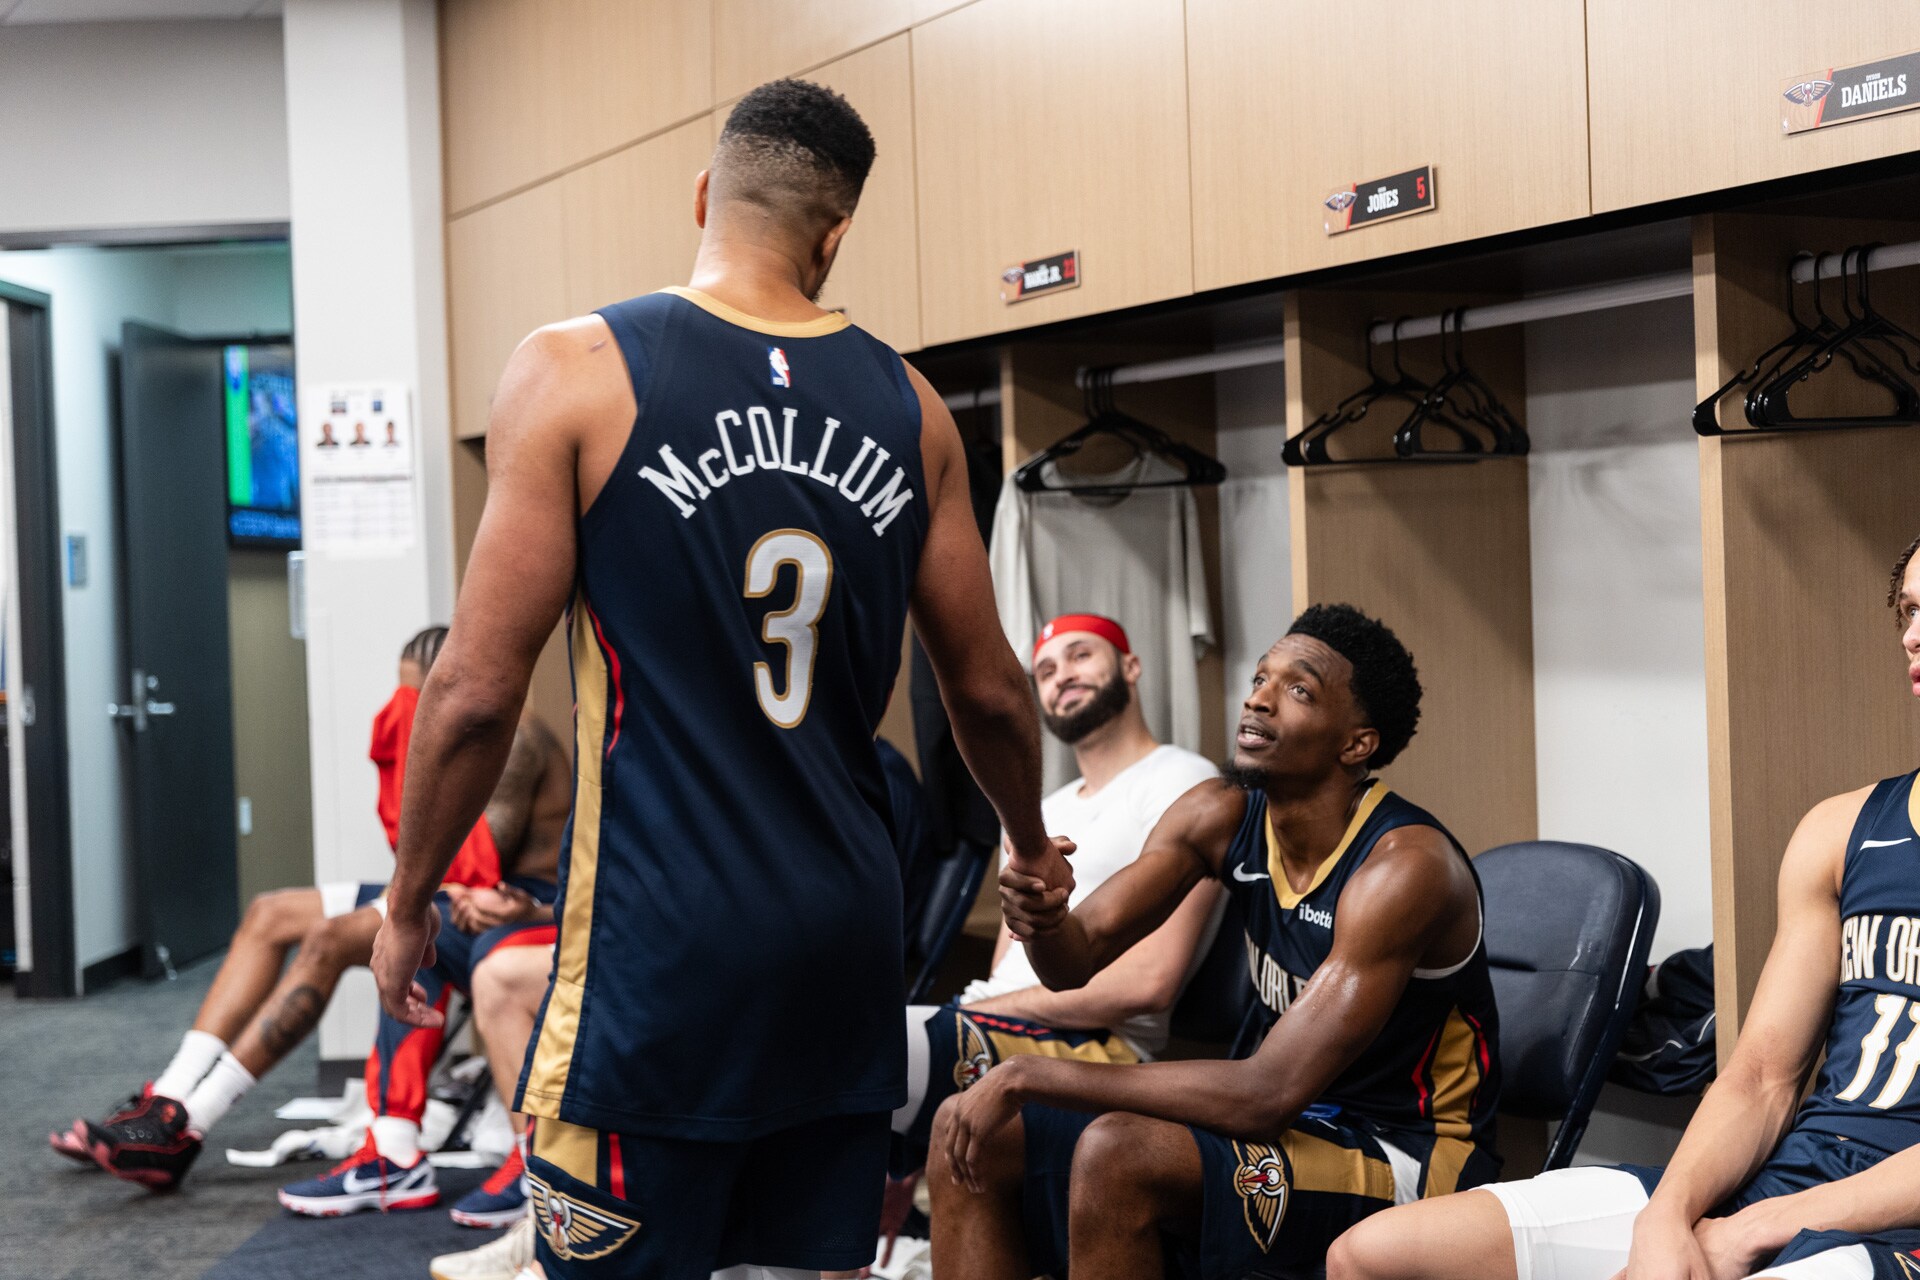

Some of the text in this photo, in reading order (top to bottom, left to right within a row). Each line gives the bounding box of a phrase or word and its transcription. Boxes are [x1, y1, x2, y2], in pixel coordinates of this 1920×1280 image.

[1841, 74, 1907, 108] DANIELS
[1367, 176, 1426, 213] JONES 5
[637, 406, 914, 537] McCOLLUM
[743, 528, 833, 729] 3
[1835, 993, 1920, 1110] 11
